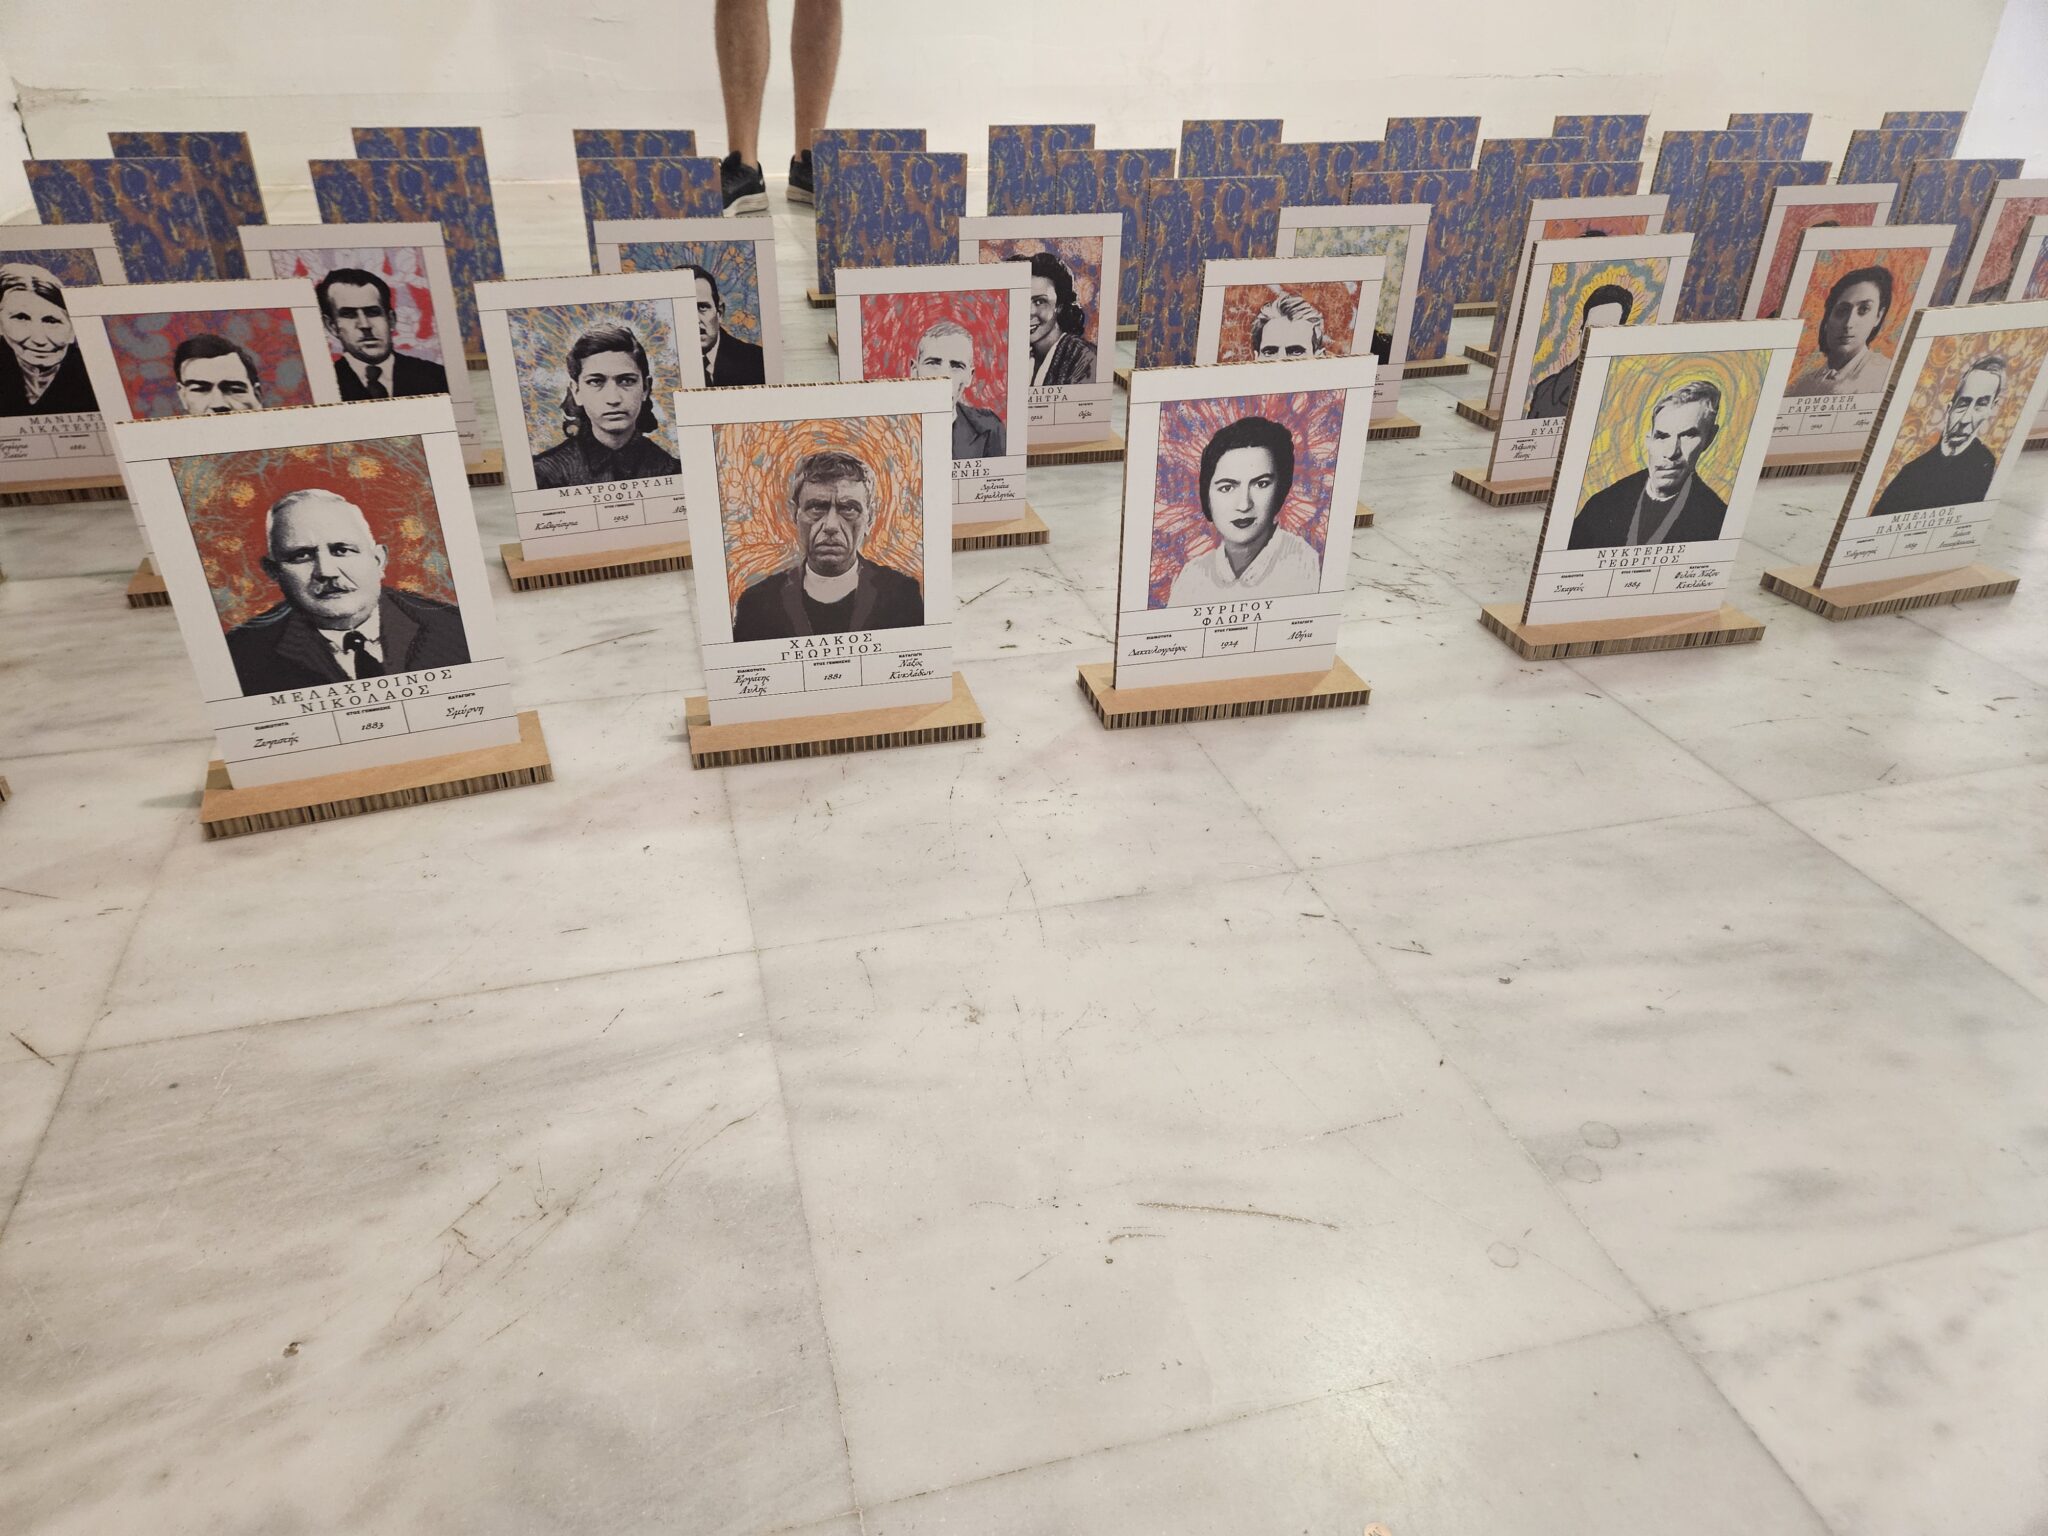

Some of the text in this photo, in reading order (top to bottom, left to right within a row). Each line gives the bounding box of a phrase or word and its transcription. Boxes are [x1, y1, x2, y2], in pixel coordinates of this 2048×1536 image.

[1029, 386, 1063, 395] ΛΙΟΥ
[1530, 426, 1563, 435] ΕΥΑΓ
[953, 460, 982, 469] ΝΑΣ
[952, 468, 990, 478] ΕΝΗΣ
[559, 477, 673, 498] ΜΑΥΡΟΦΡΥΔΗ
[592, 490, 644, 503] ΣΟΦΙΑ
[1597, 544, 1687, 559] ΝΥΚΤΕΡΗΣ
[1598, 555, 1680, 569] ΓΕΩΡΓΙΟΣ
[1193, 600, 1274, 617] ΣΥΡΙΓΟΥ
[1202, 612, 1262, 626] ΦΛΩΡΑ
[790, 633, 873, 649] ΧΑΛΚΟΣ
[781, 643, 882, 661] ΓΕΩΡΓΙΟΣ
[270, 669, 453, 706] ΜΕΛΑΧΡΟΙΝΟΣ
[301, 684, 430, 714] ΝΙΚΟΛΑΟΣ
[446, 704, 484, 719] Σμύρνη
[361, 722, 384, 731] 1883
